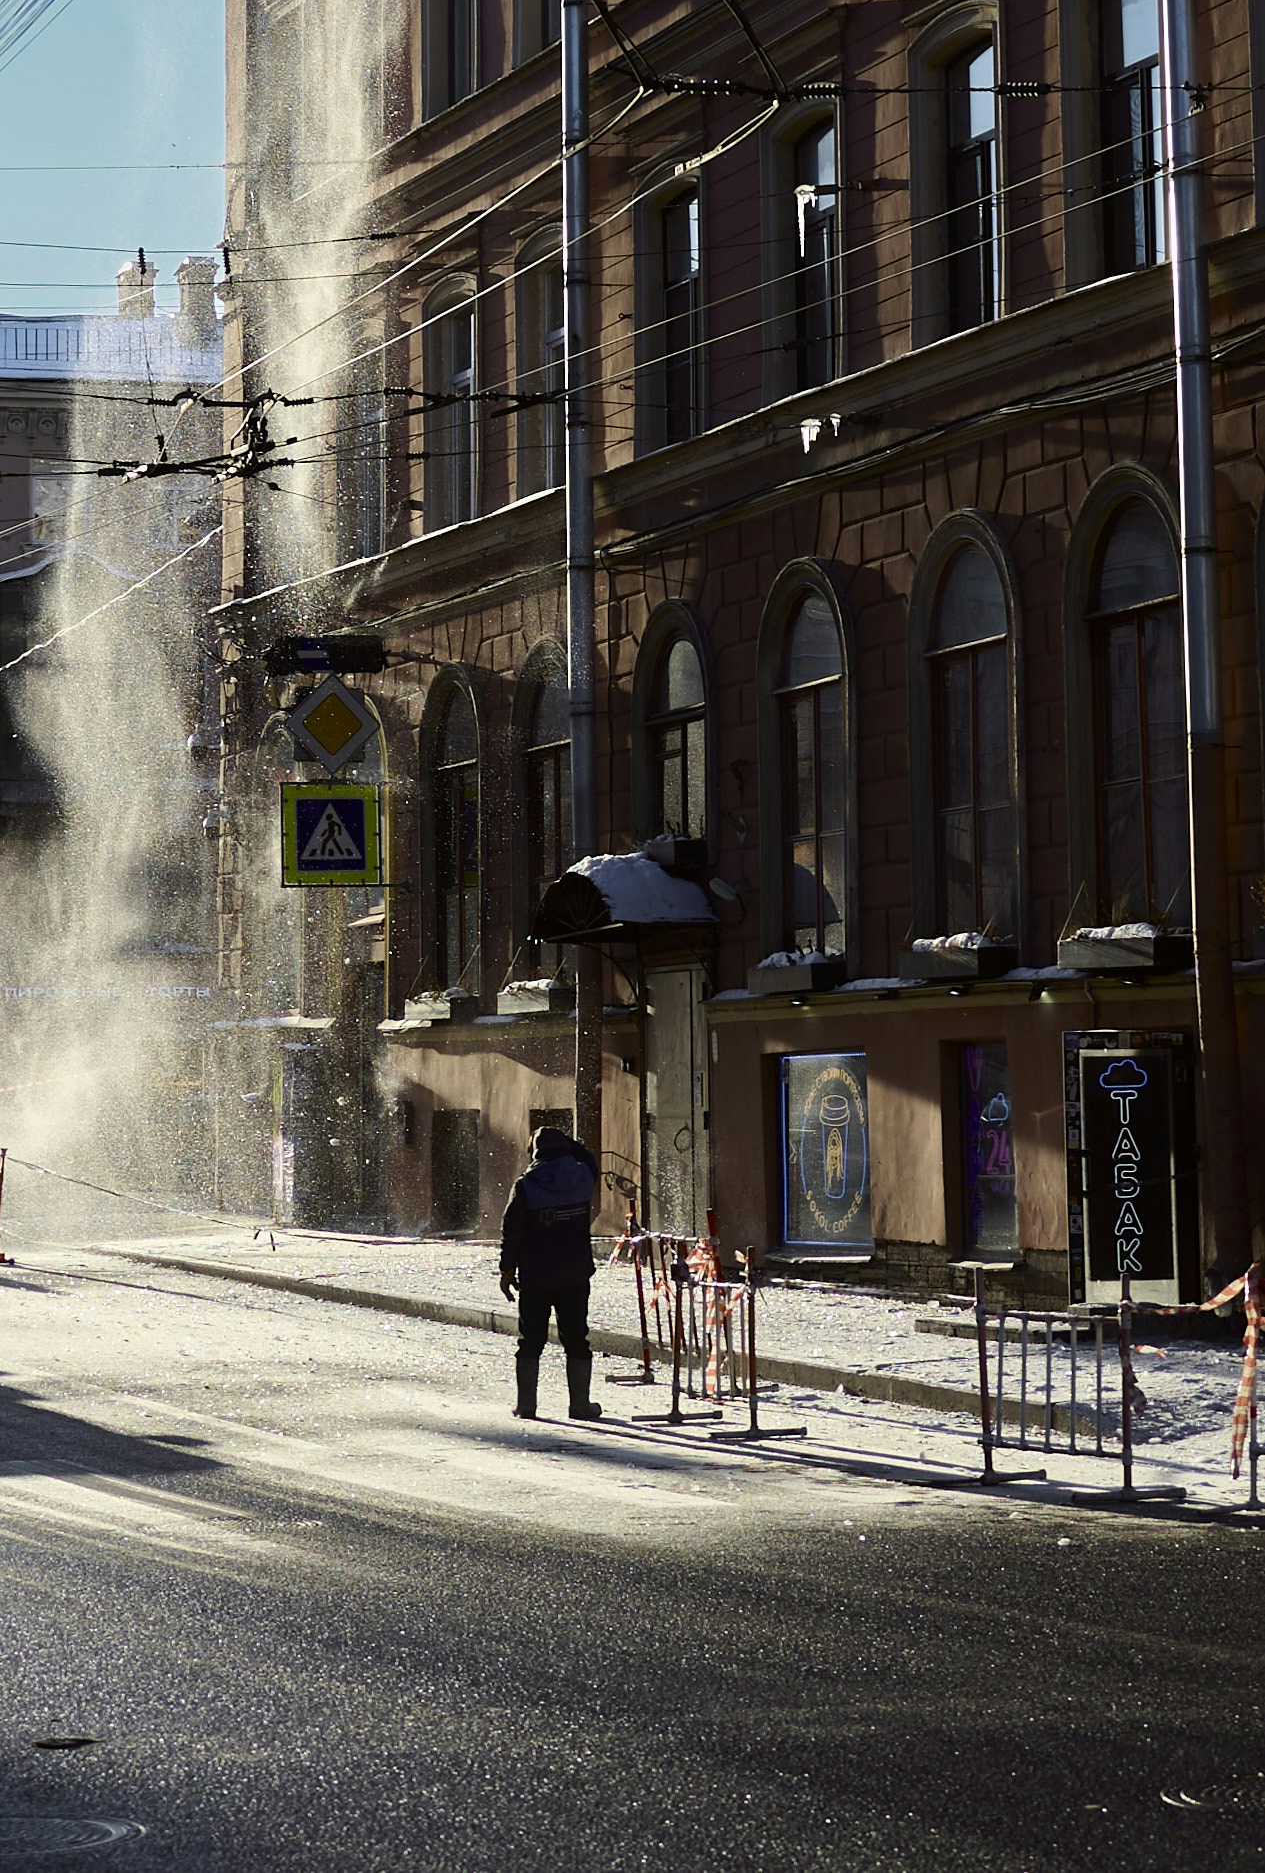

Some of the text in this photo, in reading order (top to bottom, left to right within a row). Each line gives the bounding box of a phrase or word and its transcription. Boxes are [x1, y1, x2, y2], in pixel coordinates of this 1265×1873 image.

[986, 1128, 1012, 1175] 24
[1110, 1089, 1144, 1274] ТАБАК
[805, 1189, 831, 1233] SOKOL
